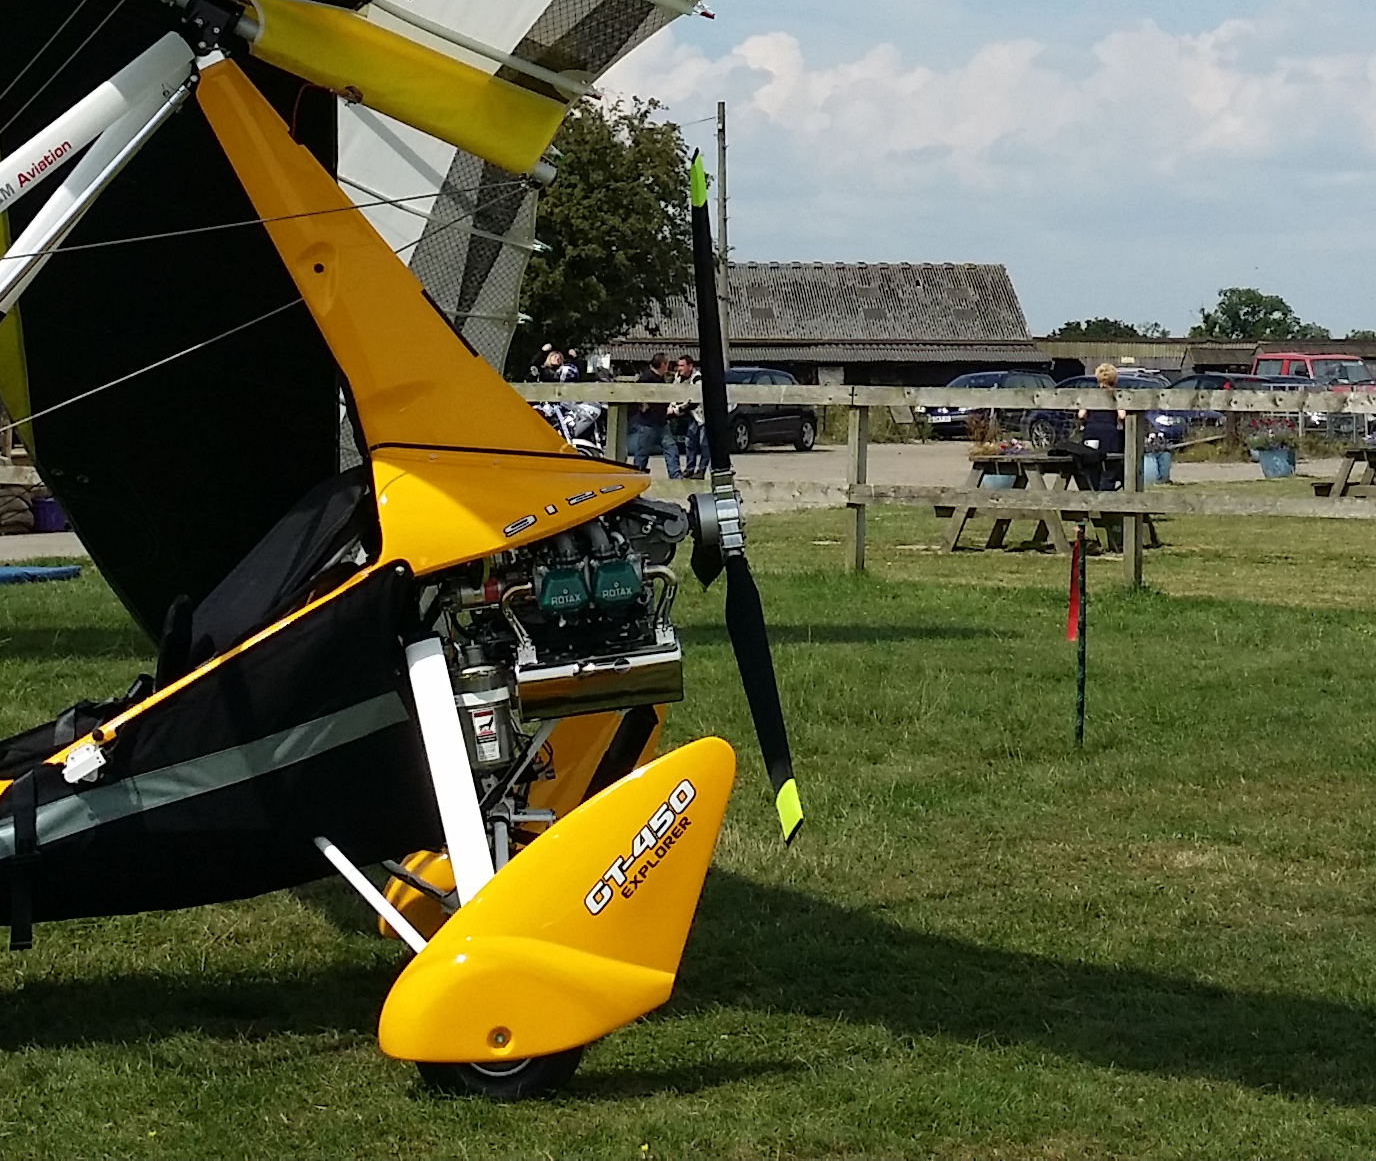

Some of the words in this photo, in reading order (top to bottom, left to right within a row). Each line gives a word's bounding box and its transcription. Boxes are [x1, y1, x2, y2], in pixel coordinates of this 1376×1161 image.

[17, 141, 72, 188] Aviation
[551, 593, 581, 605] ROTAX
[602, 587, 632, 598] ROTAX
[583, 778, 696, 916] GT-450
[621, 816, 691, 899] EXPLORER
